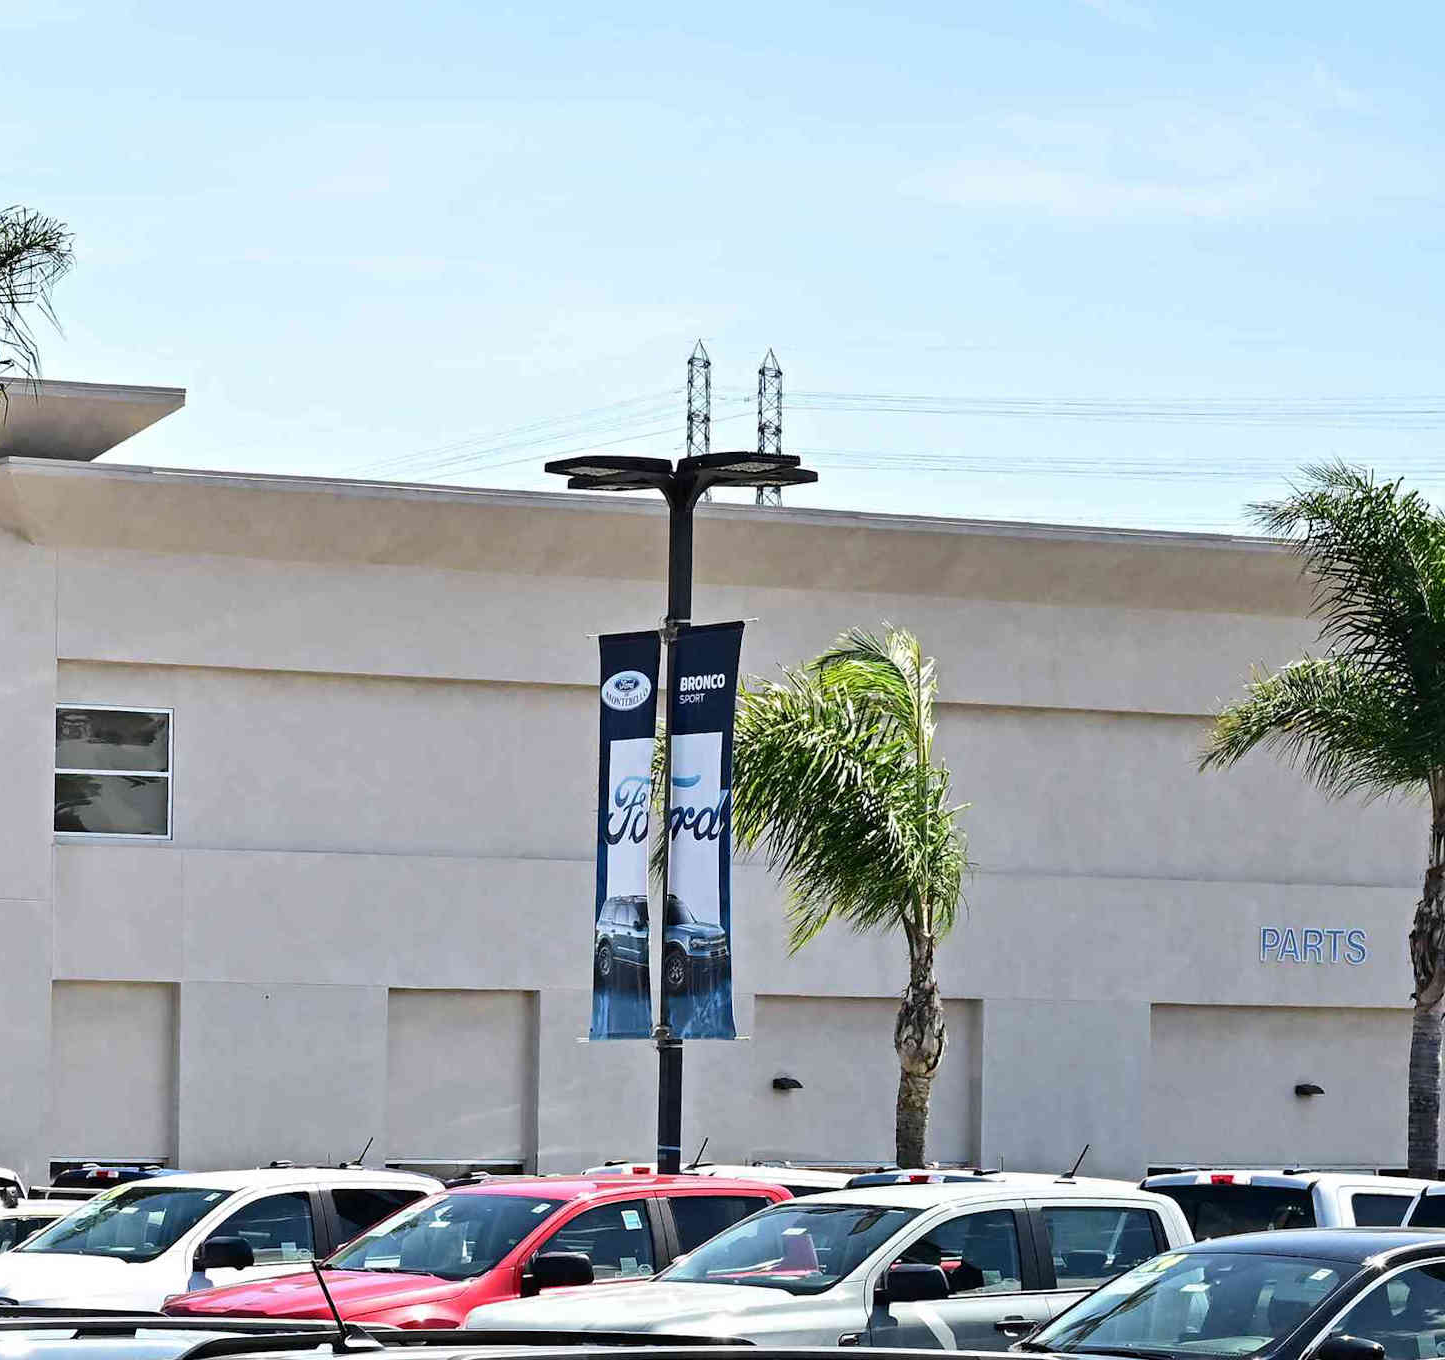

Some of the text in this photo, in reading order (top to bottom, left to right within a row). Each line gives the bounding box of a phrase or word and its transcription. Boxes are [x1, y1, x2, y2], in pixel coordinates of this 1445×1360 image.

[679, 673, 726, 692] BRONCO
[679, 693, 706, 705] SPORT
[1260, 926, 1367, 966] PARTS
